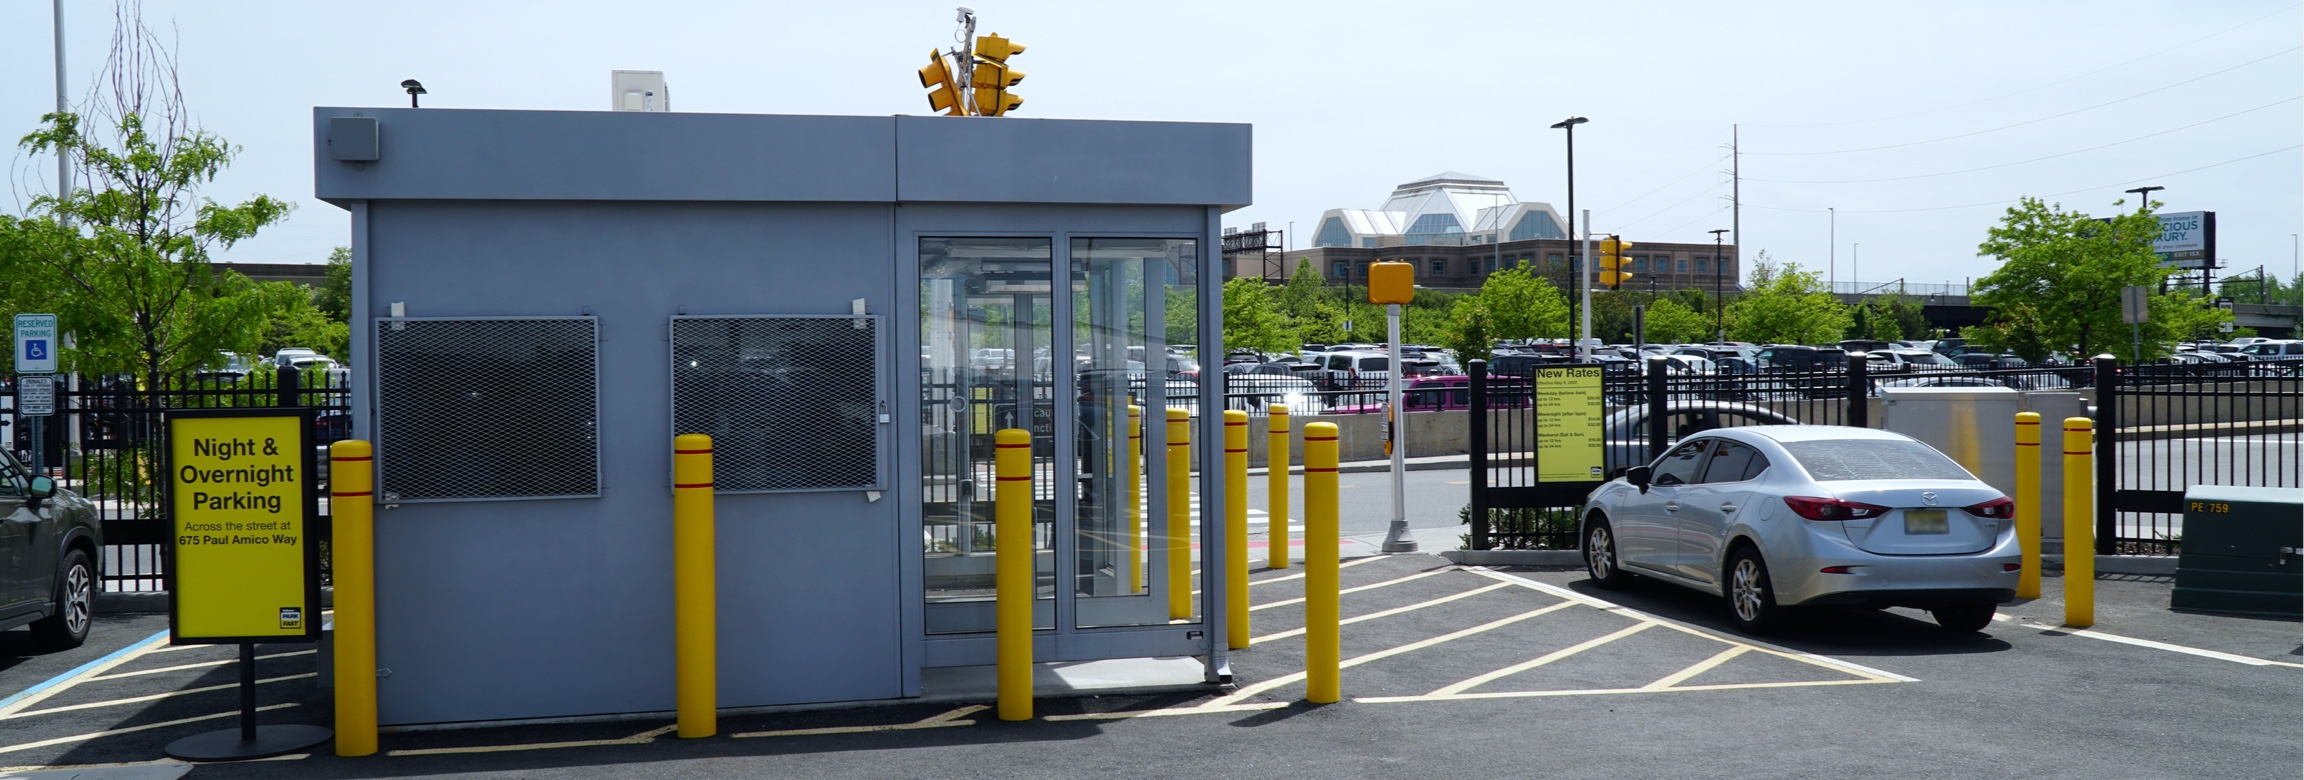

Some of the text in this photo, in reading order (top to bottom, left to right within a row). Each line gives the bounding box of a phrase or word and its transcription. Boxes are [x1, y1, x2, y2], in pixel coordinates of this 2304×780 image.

[18, 319, 53, 328] RESERVED
[21, 330, 51, 338] PARKING
[1537, 368, 1600, 378] New Rates
[194, 438, 279, 461] Night &
[180, 464, 294, 487] Overnight
[194, 492, 281, 514] Parking
[2191, 502, 2229, 513] PE 759
[184, 521, 291, 532] Across the street at
[179, 534, 297, 546] 675 Paul Amico Way
